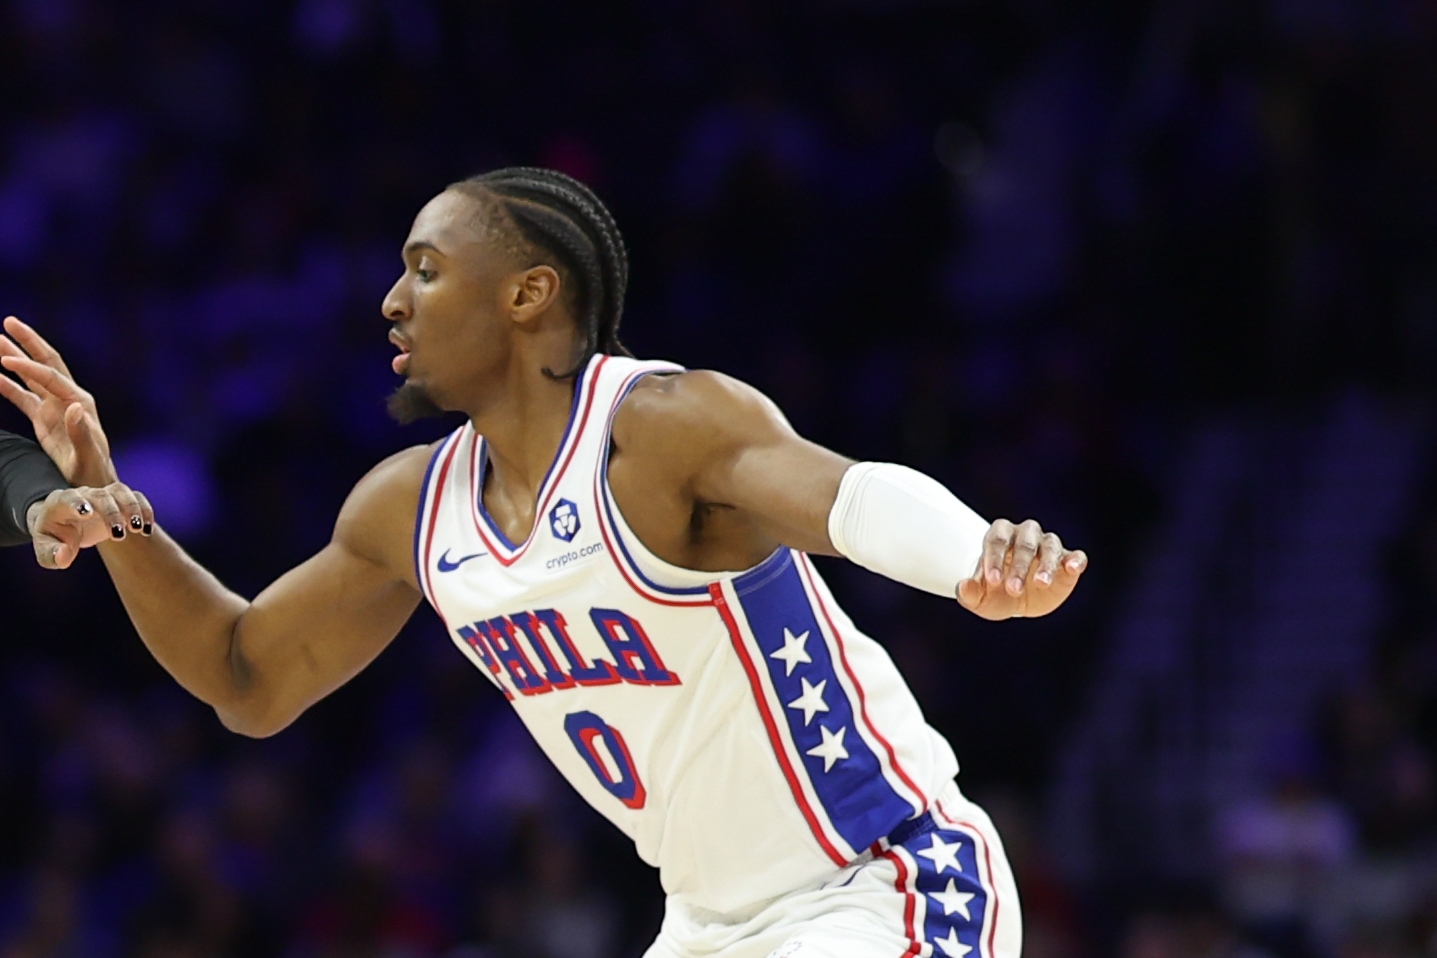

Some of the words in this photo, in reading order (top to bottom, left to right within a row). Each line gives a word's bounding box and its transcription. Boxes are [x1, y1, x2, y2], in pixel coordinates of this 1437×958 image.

[545, 541, 604, 570] crypto.com
[457, 607, 682, 702] PHILA
[564, 710, 646, 810] 0
